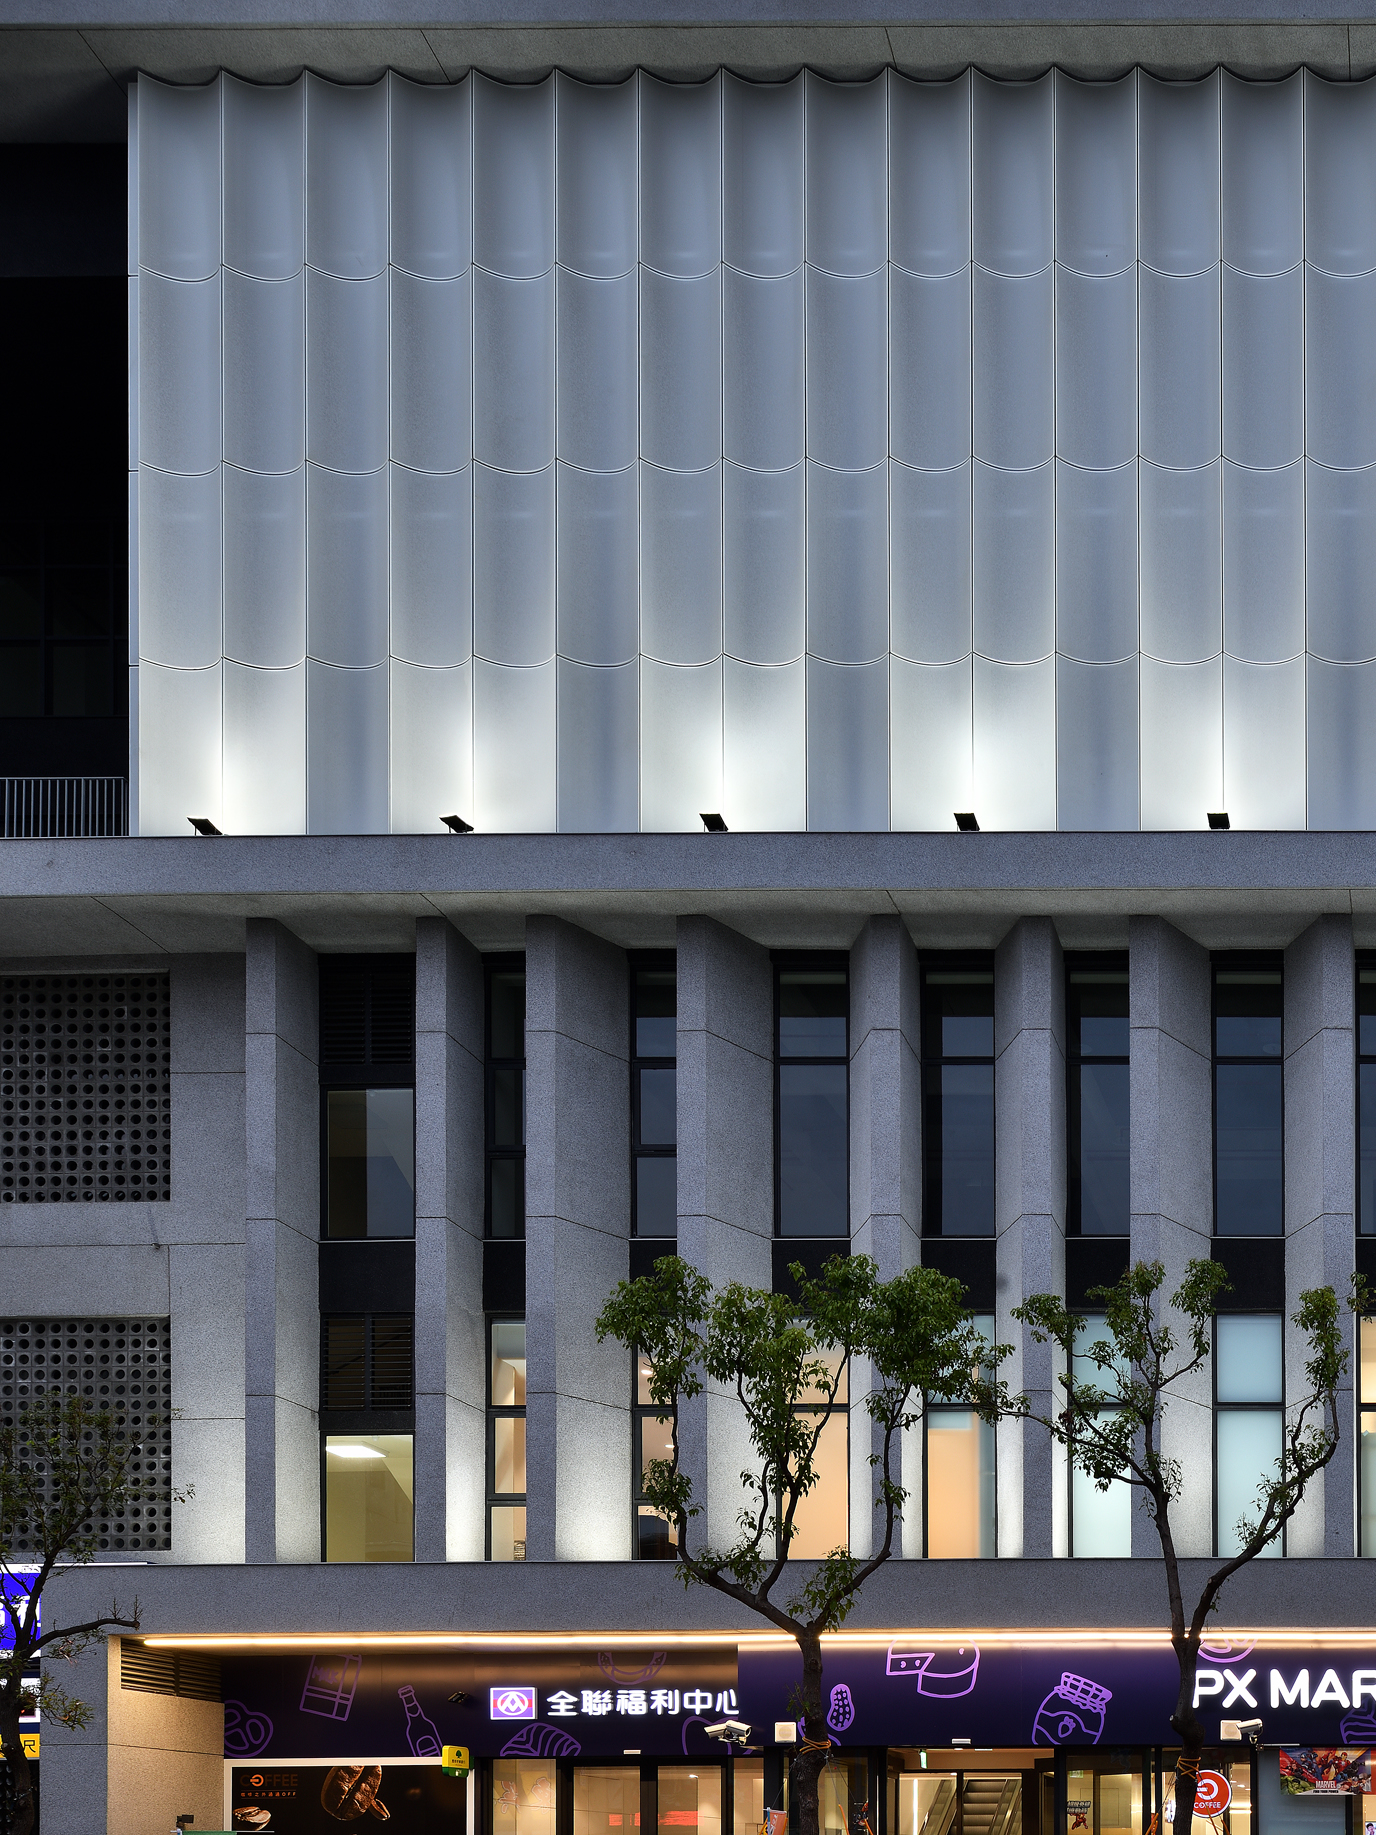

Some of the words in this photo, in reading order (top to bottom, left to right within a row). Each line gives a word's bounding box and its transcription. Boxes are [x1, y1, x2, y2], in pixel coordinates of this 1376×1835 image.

[1192, 1668, 1258, 1709] PX
[546, 1688, 740, 1716] 全聯福利中心
[1315, 1780, 1336, 1789] MARVEL
[1193, 1801, 1222, 1809] COFFEE
